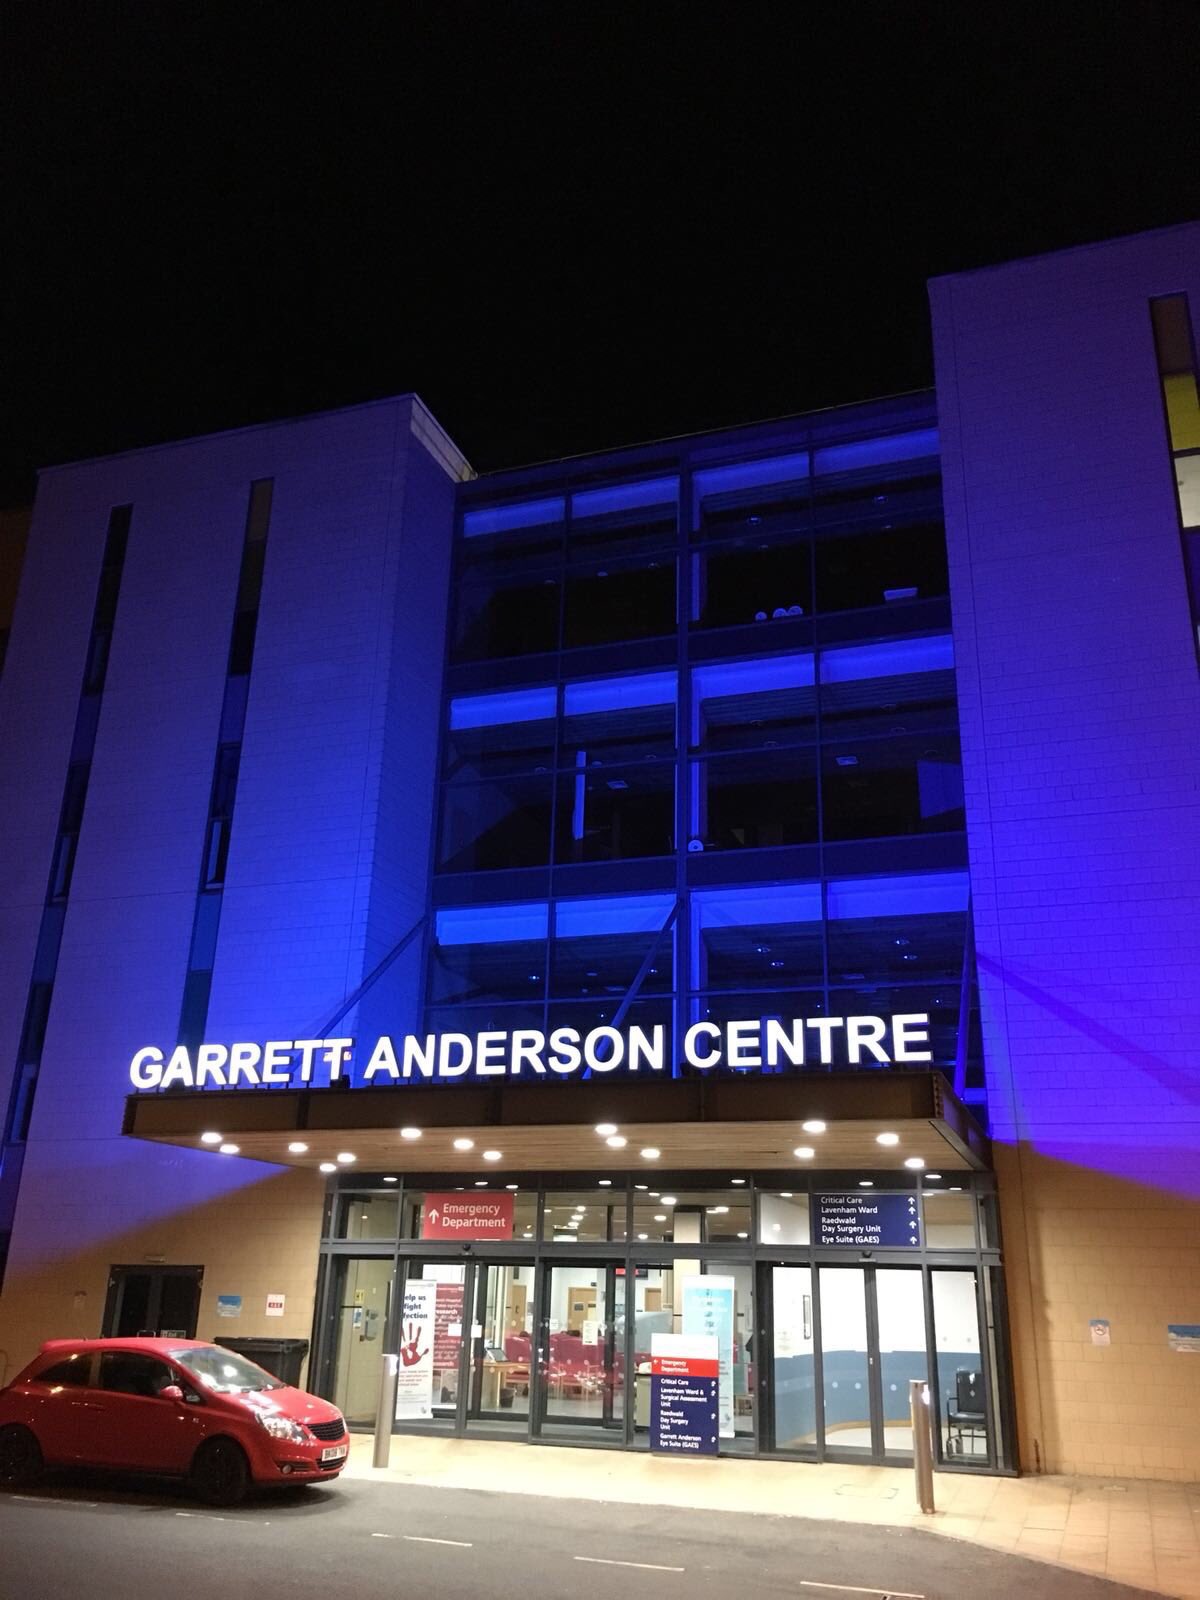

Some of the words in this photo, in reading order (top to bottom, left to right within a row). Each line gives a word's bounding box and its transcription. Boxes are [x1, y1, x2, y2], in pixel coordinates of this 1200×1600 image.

[129, 1037, 353, 1089] GARRETT
[363, 1024, 665, 1079] ANDERSON
[684, 1013, 933, 1069] CENTRE
[820, 1196, 845, 1204] Critical
[846, 1196, 863, 1204] Care
[443, 1203, 500, 1216] Emergency
[821, 1206, 857, 1214] Lavenham
[858, 1206, 878, 1214] Ward
[442, 1216, 506, 1230] Department
[821, 1216, 856, 1224] Raedwald
[821, 1224, 836, 1233] Day
[837, 1224, 864, 1234] Surgery
[822, 1236, 834, 1244] Eye
[855, 1236, 880, 1244] (GAES)
[670, 1418, 688, 1426] Surgery
